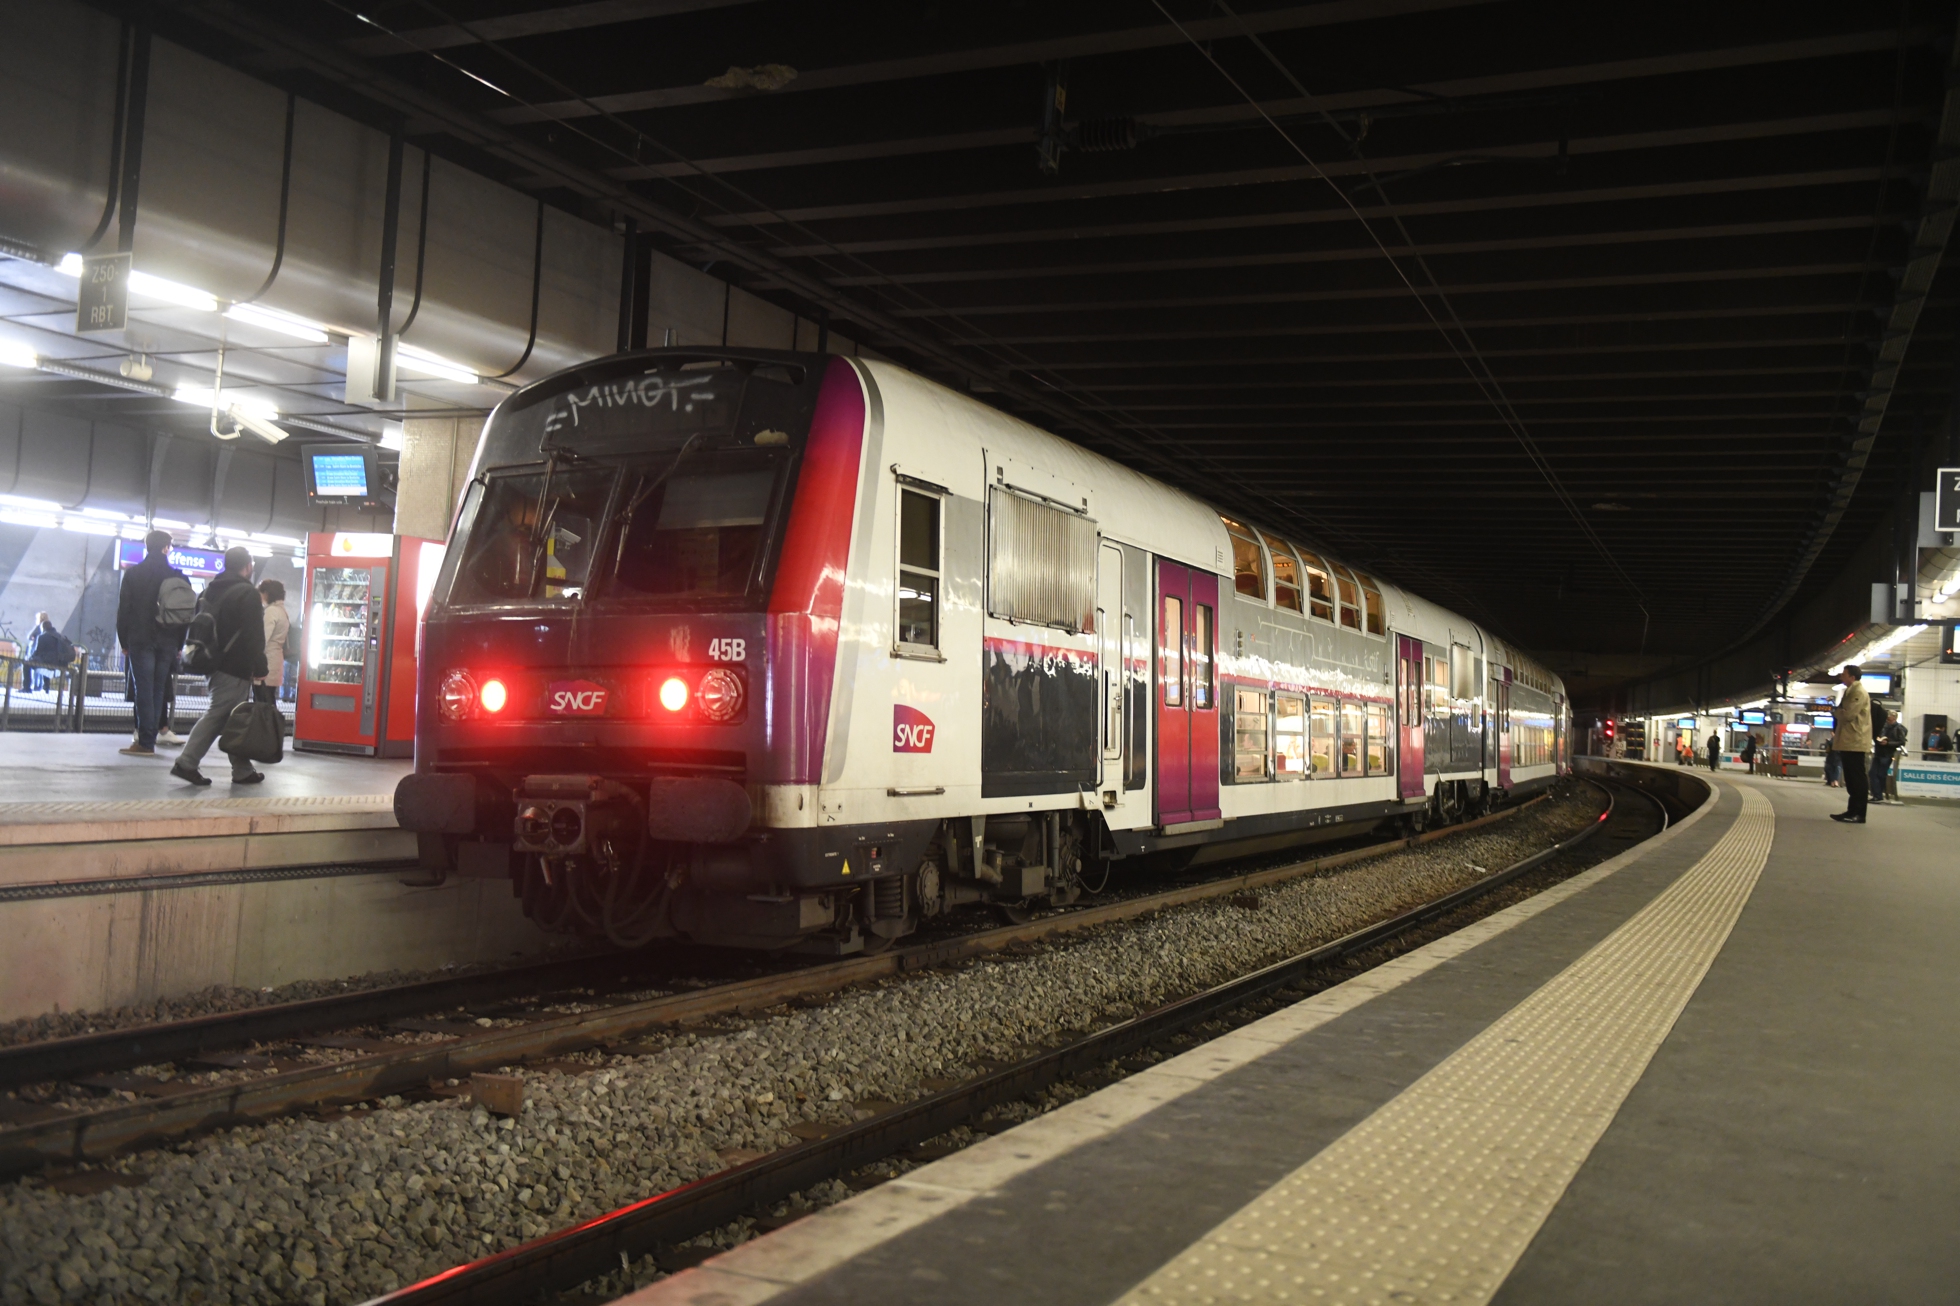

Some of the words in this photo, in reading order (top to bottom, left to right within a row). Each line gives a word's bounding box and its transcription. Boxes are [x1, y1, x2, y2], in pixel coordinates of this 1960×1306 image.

[92, 265, 115, 283] Z50
[101, 286, 107, 303] 1
[91, 304, 114, 323] RBT
[167, 551, 206, 568] éfense
[708, 637, 746, 662] 45B
[550, 690, 605, 711] SNCF
[894, 723, 933, 748] SNCF
[1903, 772, 1926, 780] SALLE
[1926, 773, 1942, 781] DES
